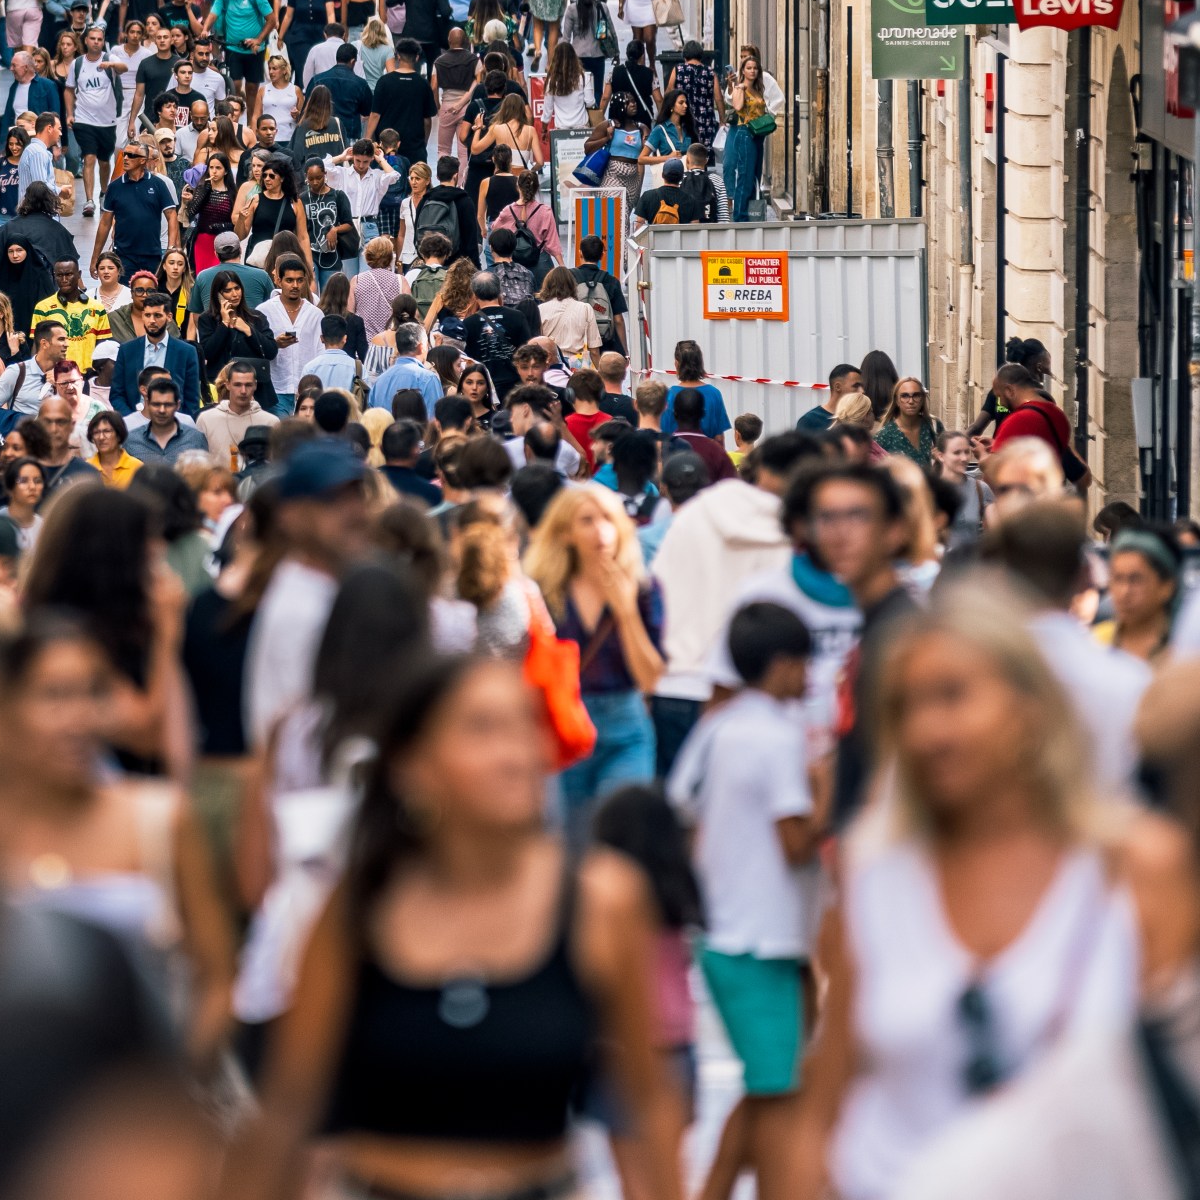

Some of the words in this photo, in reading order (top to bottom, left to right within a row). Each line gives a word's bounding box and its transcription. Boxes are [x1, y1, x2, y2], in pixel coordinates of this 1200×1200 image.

[877, 27, 958, 42] promenade
[747, 258, 780, 266] CHANTIER
[749, 267, 778, 275] INTERDIT
[747, 276, 757, 284] AU
[759, 276, 782, 284] PUBLIC
